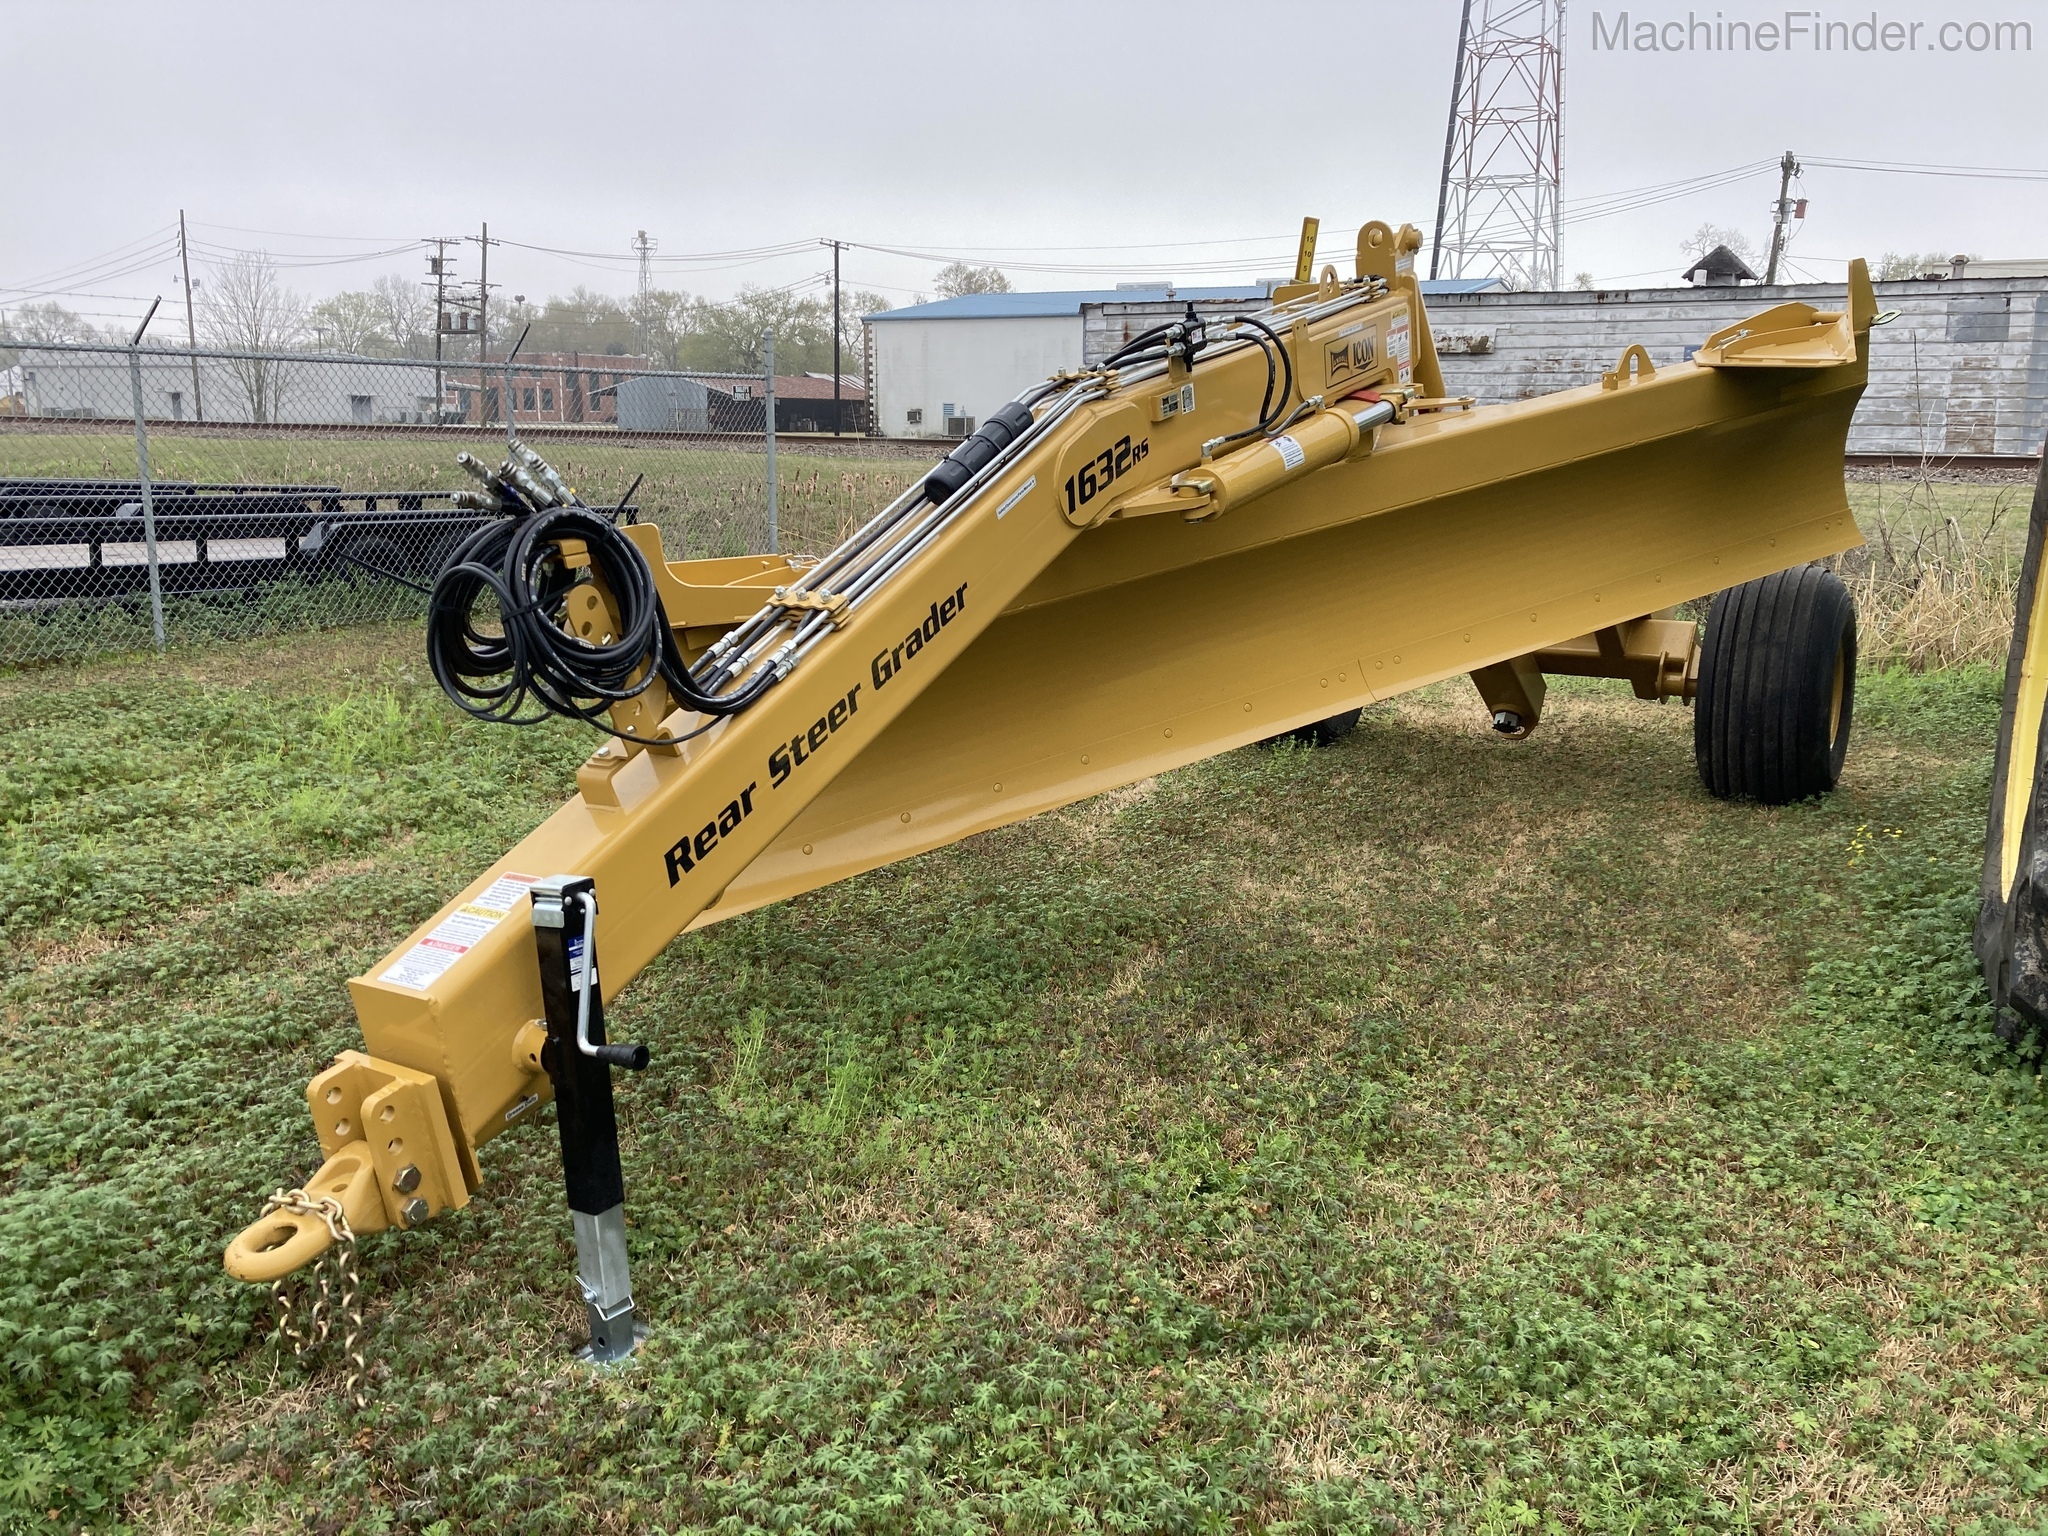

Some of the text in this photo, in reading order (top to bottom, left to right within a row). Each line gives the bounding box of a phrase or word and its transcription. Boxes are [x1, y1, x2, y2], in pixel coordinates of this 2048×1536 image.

[1306, 235, 1314, 243] 15
[1304, 250, 1312, 258] 10
[1353, 335, 1374, 366] ICON
[664, 581, 969, 889] Rear Steer Grader
[467, 905, 505, 919] CAUTION
